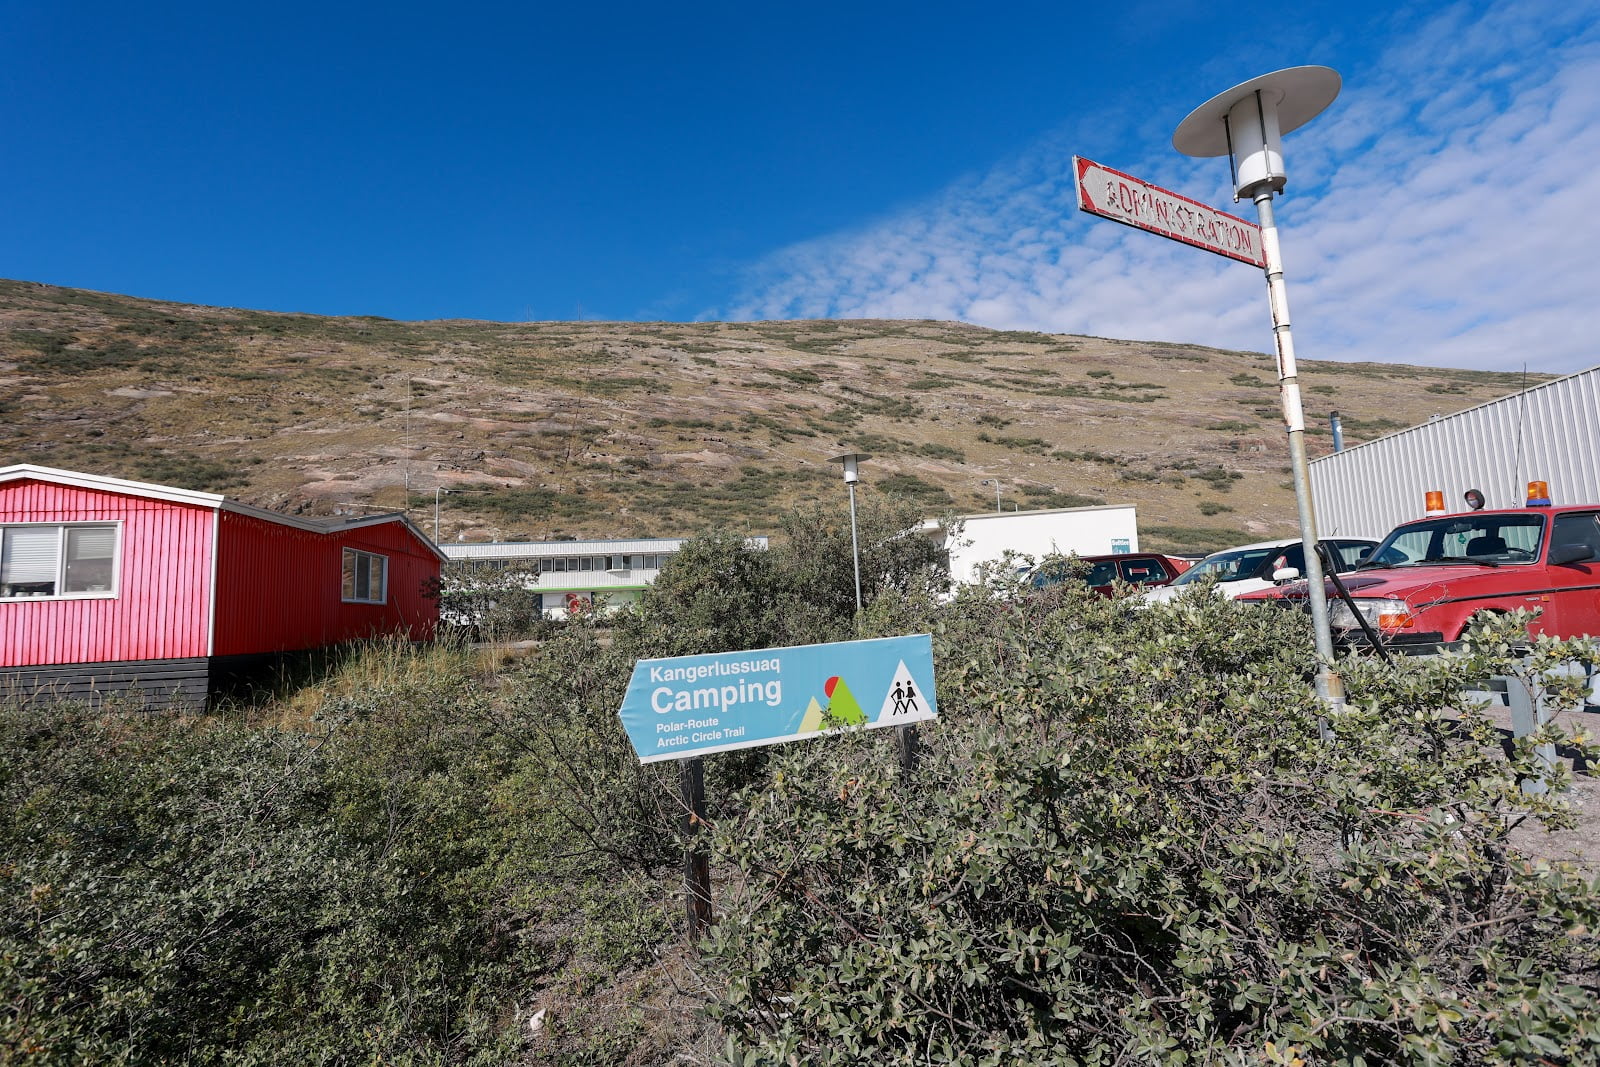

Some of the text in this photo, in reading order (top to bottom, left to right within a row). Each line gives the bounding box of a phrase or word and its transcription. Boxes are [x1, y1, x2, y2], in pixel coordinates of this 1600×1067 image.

[650, 658, 781, 683] Kangerlussuaq
[651, 679, 782, 714] Camping
[656, 718, 719, 733] Polar-Route
[657, 726, 745, 748] Arctic Circle Trail
